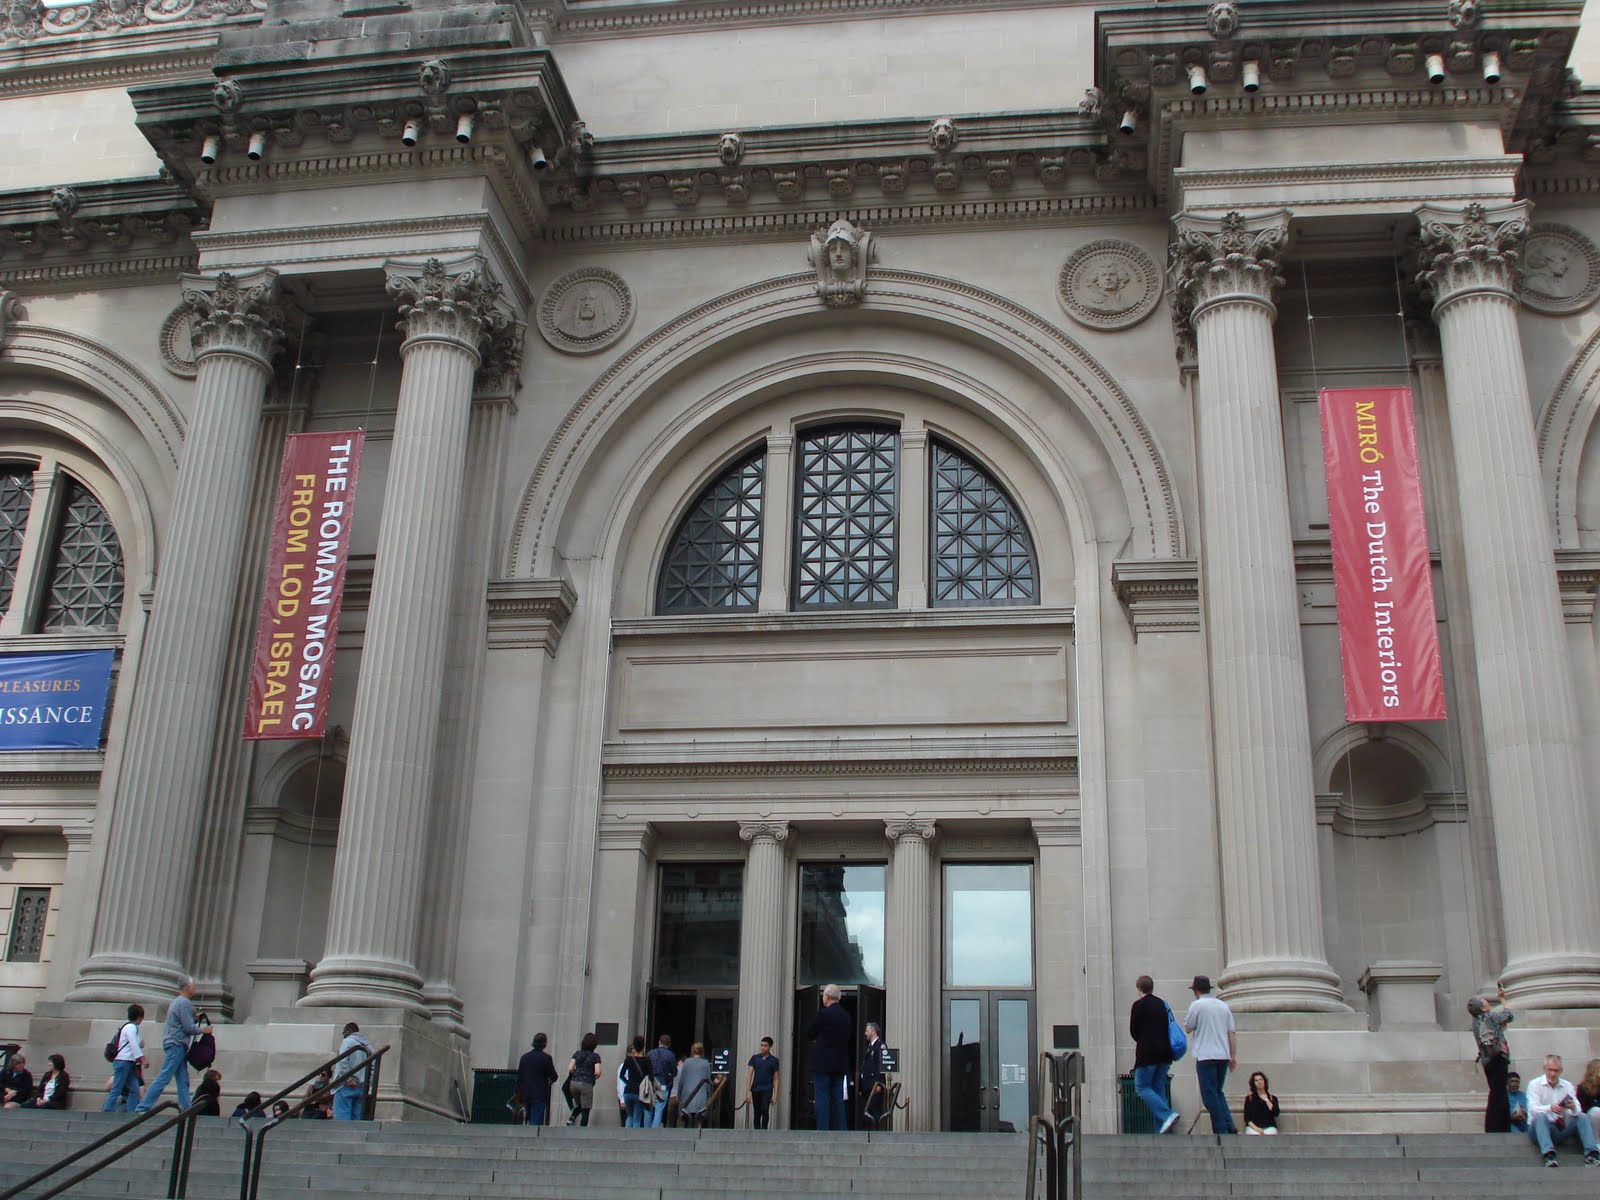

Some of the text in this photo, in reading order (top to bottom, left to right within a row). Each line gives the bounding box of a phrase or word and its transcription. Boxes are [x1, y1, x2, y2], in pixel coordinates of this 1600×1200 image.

[1355, 401, 1384, 464] MIRÓ
[257, 474, 317, 734] FROM LOD, ISRAEL
[291, 439, 352, 731] THE ROMAN MOSAIC
[1362, 469, 1401, 708] The Dutch Interiors
